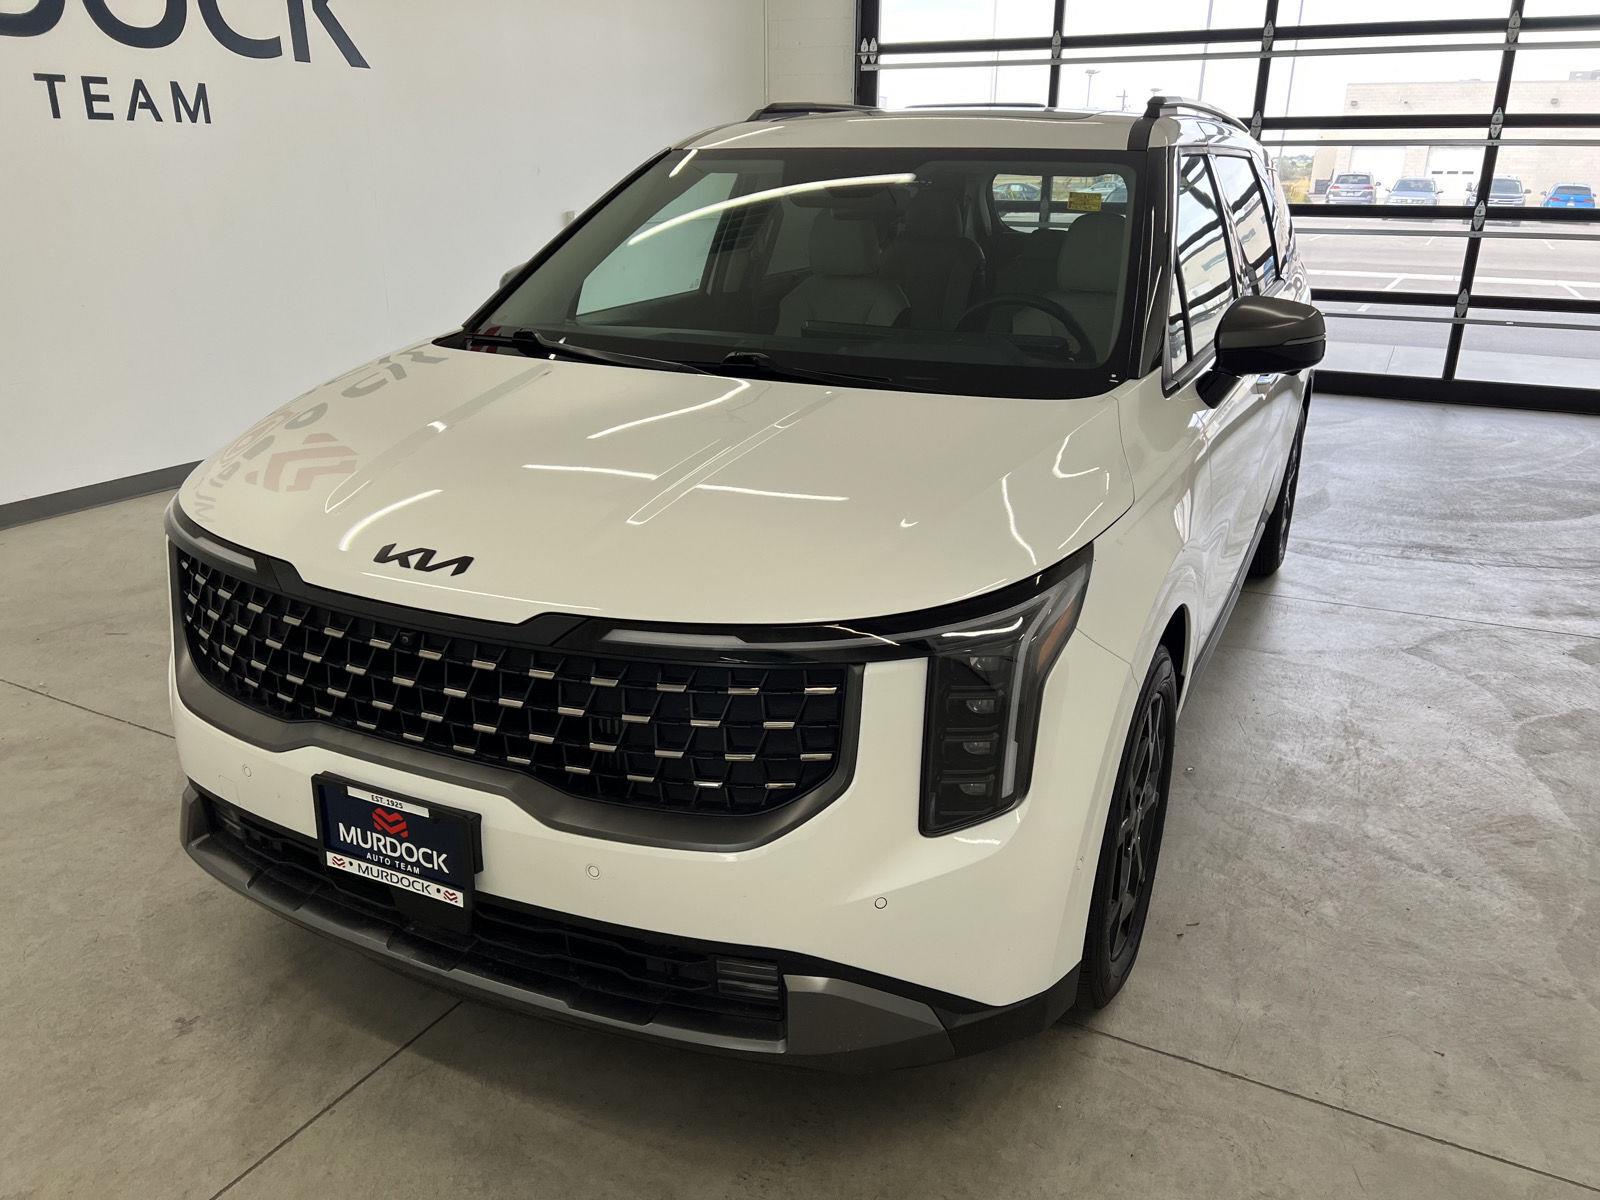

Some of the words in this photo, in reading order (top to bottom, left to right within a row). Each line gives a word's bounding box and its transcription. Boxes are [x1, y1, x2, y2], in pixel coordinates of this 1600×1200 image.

[0, 0, 371, 69] OCK
[33, 72, 212, 124] TEAM
[371, 794, 386, 805] EST.
[386, 798, 403, 809] 1925
[338, 822, 449, 874] MURDOCK
[366, 852, 391, 866] AUTO
[394, 860, 420, 875] TEAM
[357, 862, 431, 895] MURDOCK
